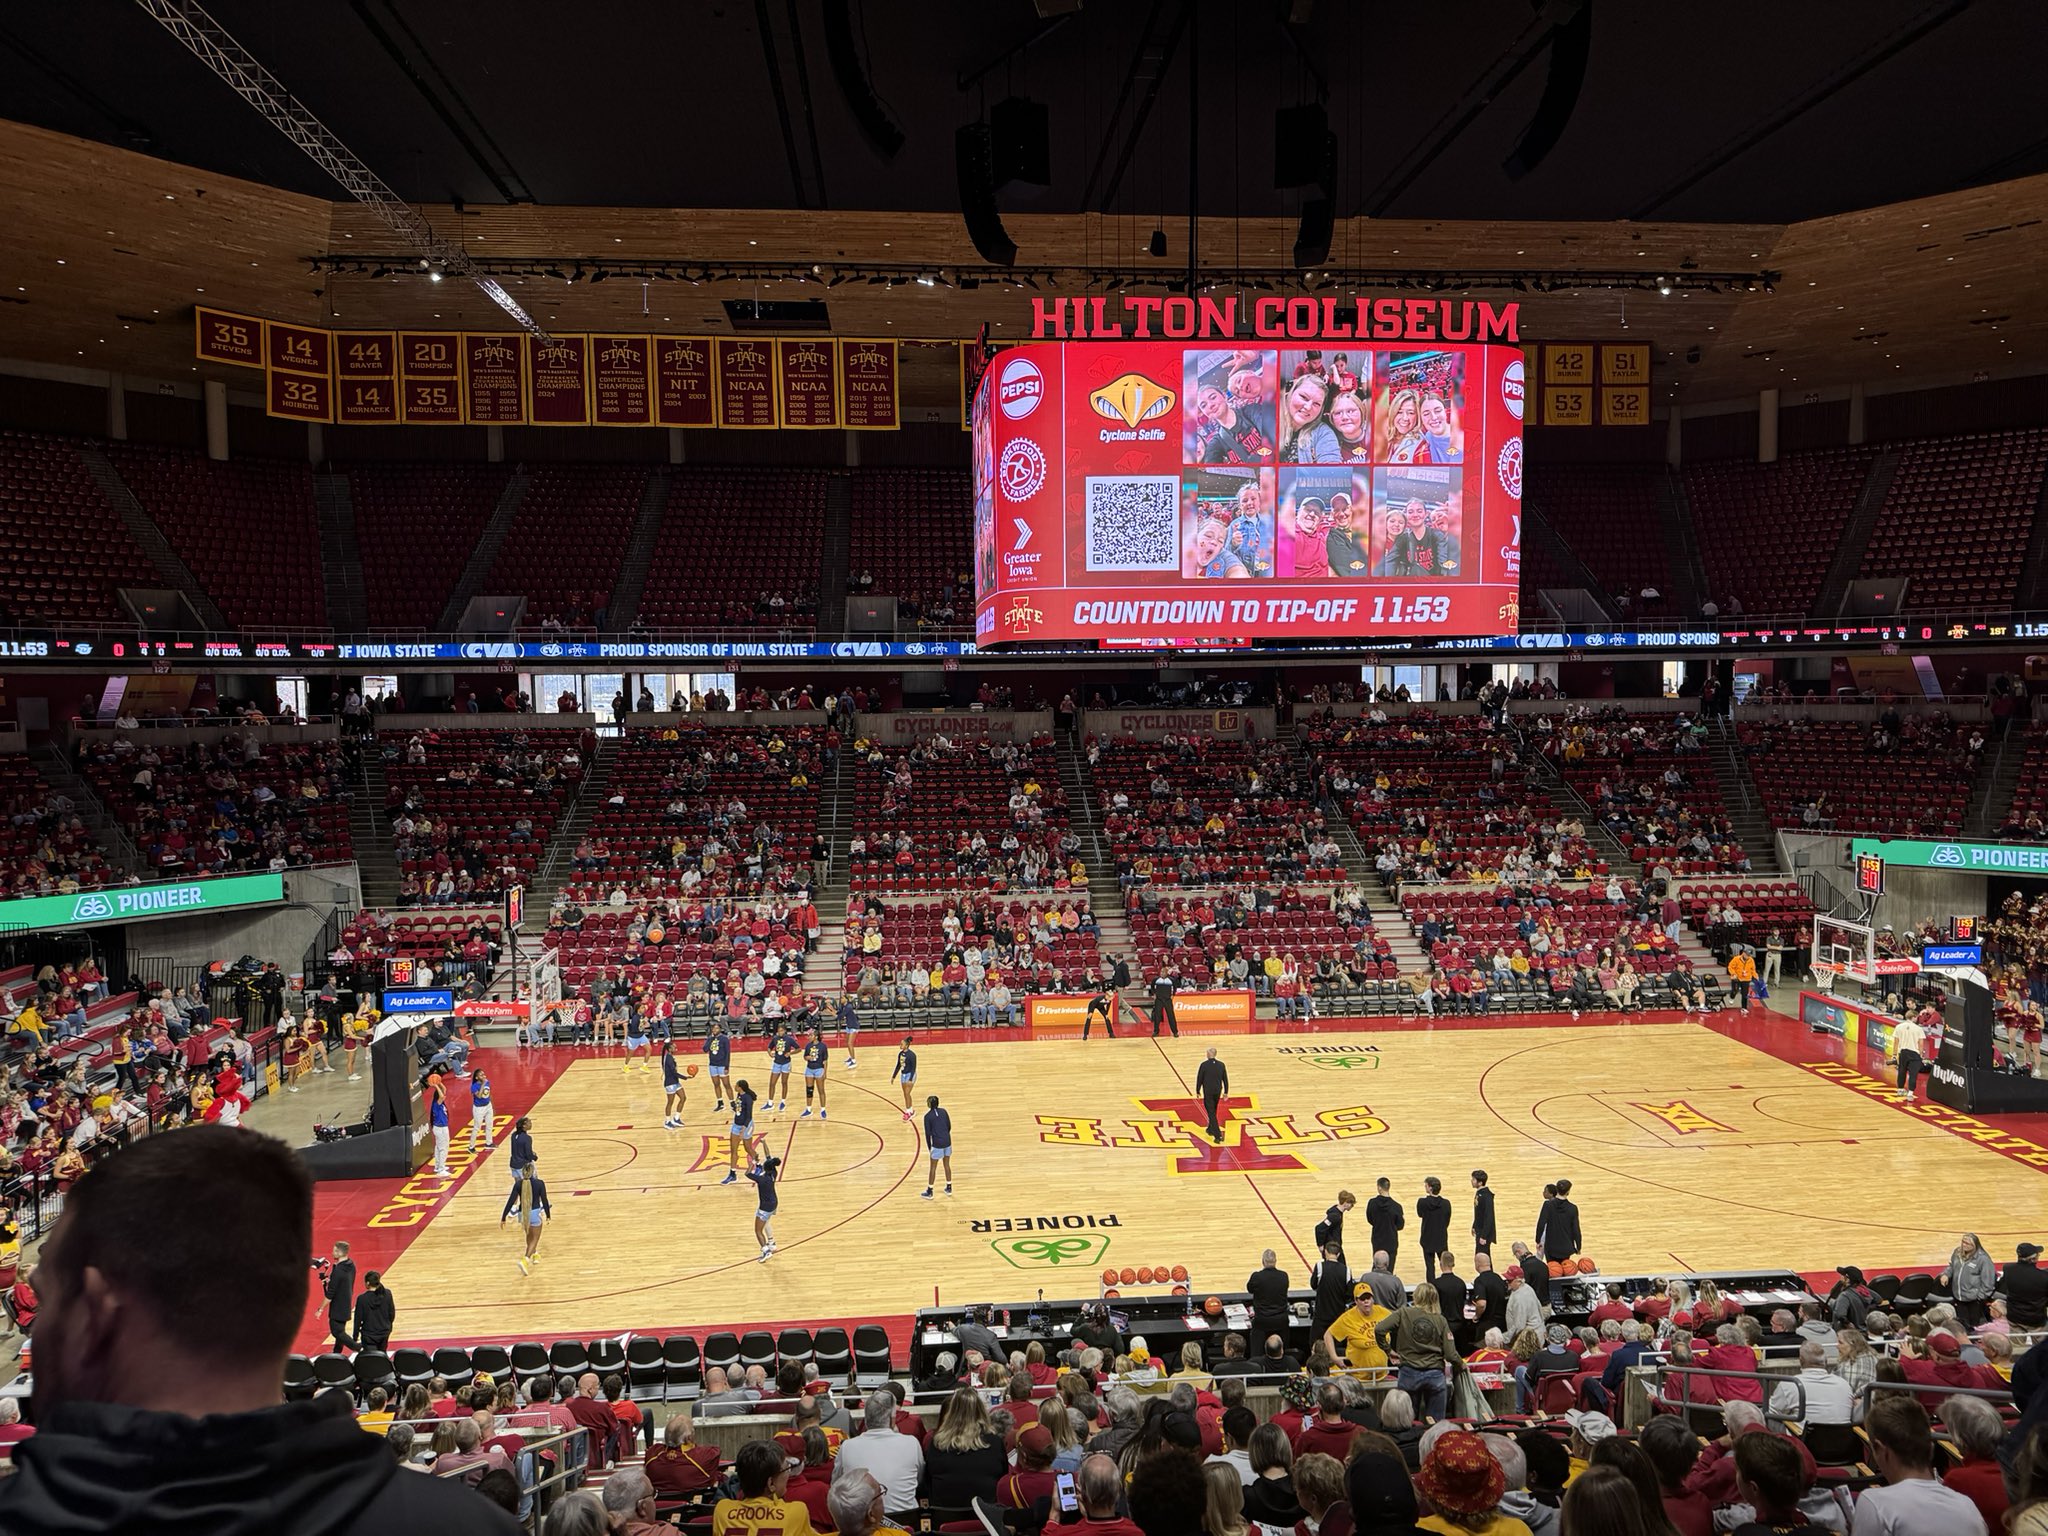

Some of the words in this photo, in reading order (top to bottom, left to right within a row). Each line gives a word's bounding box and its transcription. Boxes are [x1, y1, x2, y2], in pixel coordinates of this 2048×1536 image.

[1031, 297, 1238, 338] HILTON
[1255, 297, 1520, 342] COLISEUM
[214, 322, 249, 346] 35
[211, 342, 253, 356] STEVENS
[286, 336, 313, 358] 14
[348, 342, 382, 361] 44
[414, 343, 447, 361] 20
[474, 346, 515, 362] STATE
[281, 354, 319, 366] WEGNER
[537, 347, 578, 362] STATE
[601, 348, 641, 363] STATE
[664, 350, 704, 365] STATE
[726, 351, 766, 366] STATE
[788, 351, 828, 366] STATE
[849, 352, 888, 367] STATE
[1555, 353, 1583, 370] 42
[1615, 353, 1637, 370] 51
[284, 380, 318, 403] 32
[670, 379, 699, 390] NIT
[729, 381, 765, 391] NCAA
[791, 382, 827, 392] NCAA
[852, 382, 887, 392] NCAA
[1001, 379, 1040, 400] PEPSI
[355, 387, 380, 406] 14
[416, 387, 448, 406] 35
[1555, 394, 1582, 411] 53
[1612, 394, 1639, 411] 32
[282, 400, 320, 411] HOIBERG
[1099, 429, 1137, 443] Cyclone
[1138, 428, 1166, 441] Selfie
[1010, 478, 1038, 498] FARMS
[1003, 552, 1042, 565] Greater
[1009, 564, 1034, 577] Iowa
[1004, 606, 1043, 626] STATE
[1073, 600, 1225, 625] COUNTDOWN
[1230, 599, 1260, 623] TO
[1265, 599, 1358, 623] TIP-OFF
[1370, 596, 1450, 623] 11:53
[1813, 634, 1820, 642] 0
[1842, 633, 1849, 641] 0
[1882, 632, 1889, 640] 0
[1921, 627, 1932, 640] 0
[1989, 627, 2007, 636] 1ST
[1519, 633, 1566, 648] CVA
[1585, 634, 1605, 645] CVA
[1637, 633, 1676, 646] PROUD
[1786, 635, 1792, 643] 0
[0, 641, 48, 656] 11:53
[113, 643, 125, 657] 0
[158, 648, 165, 656] 0
[205, 648, 220, 657] 0/0
[222, 648, 242, 657] 0.0%
[255, 648, 270, 657] 0/0
[272, 648, 291, 657] 0.0%
[310, 649, 325, 657] 0/0
[356, 645, 392, 658] IOWA
[395, 644, 436, 658] STATE
[466, 643, 517, 658] CVA
[541, 645, 562, 656] CVA
[600, 644, 644, 657] PROUD
[648, 643, 708, 657] SPONSOR
[711, 643, 729, 657] OF
[732, 643, 766, 657] IOWA
[769, 643, 808, 657] STATE
[836, 642, 883, 657] CVA
[904, 644, 926, 655] CVA
[1121, 714, 1213, 730] CYCLONES
[1861, 859, 1880, 872] 11:53
[1862, 870, 1877, 889] 30
[1957, 918, 1974, 927] 11:53
[1957, 927, 1971, 938] 30
[1929, 952, 1940, 960] Ag
[1941, 951, 1967, 959] Leader
[392, 962, 412, 971] 11:53
[394, 971, 409, 983] 30
[390, 998, 402, 1007] Ag
[404, 997, 434, 1005] Leader
[1276, 1045, 1382, 1054] PIONEER
[1800, 1061, 1918, 1104] IOWA
[1034, 1104, 1390, 1149] STATE
[970, 1214, 1123, 1233] PIONEER
[727, 1506, 785, 1521] CROOKS
